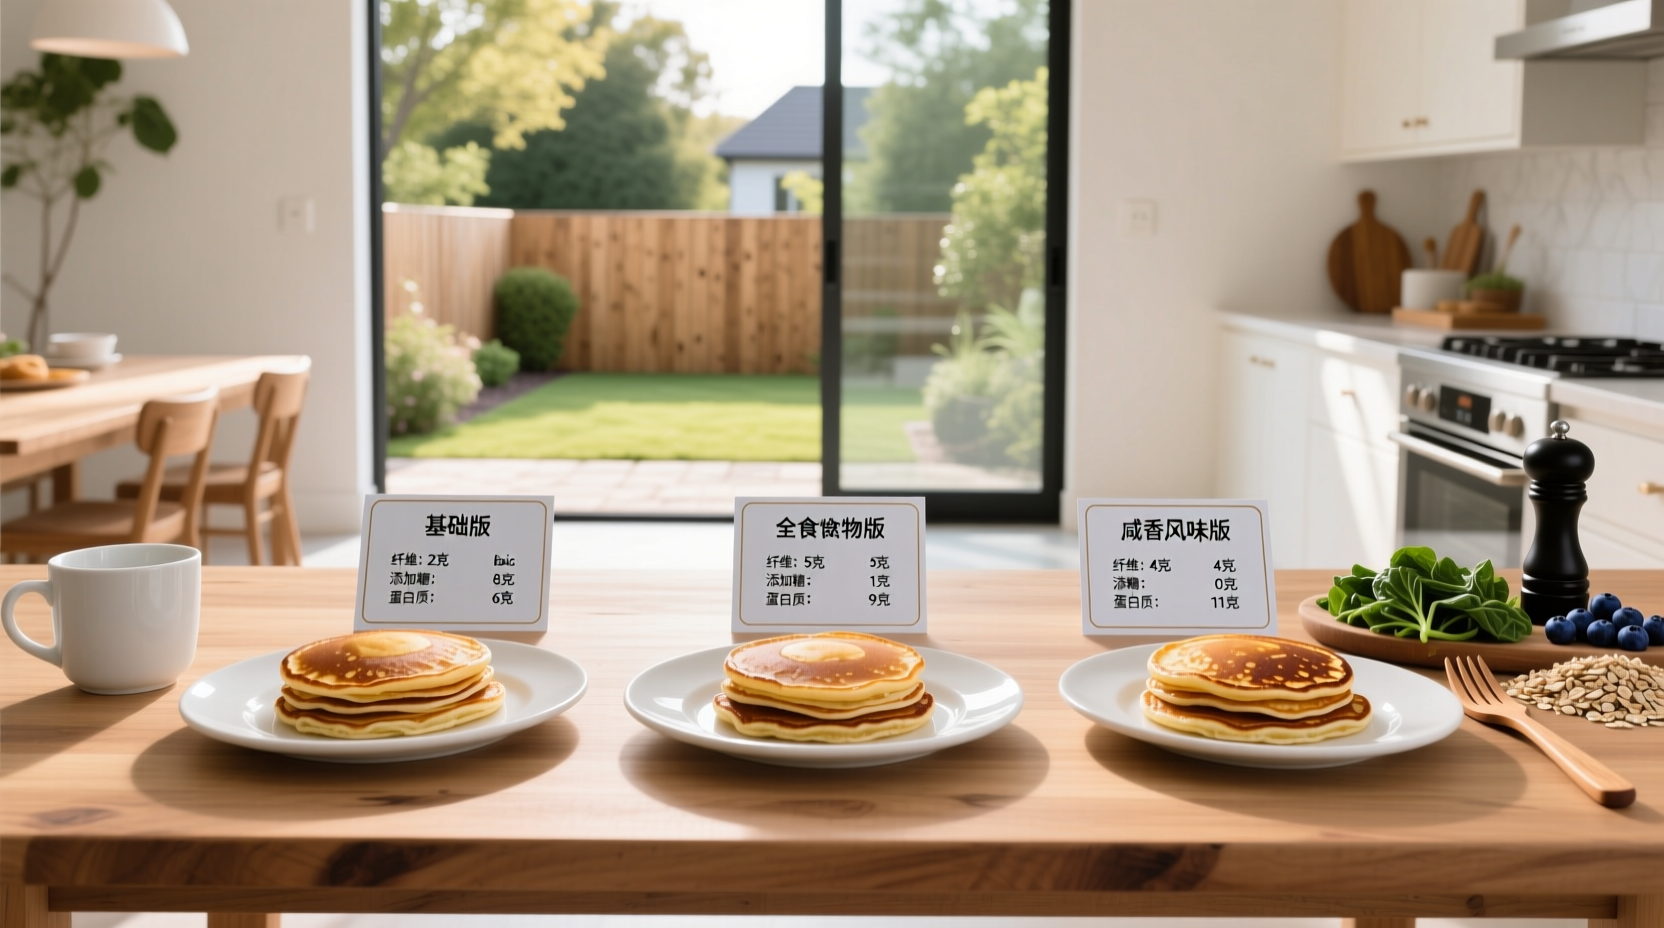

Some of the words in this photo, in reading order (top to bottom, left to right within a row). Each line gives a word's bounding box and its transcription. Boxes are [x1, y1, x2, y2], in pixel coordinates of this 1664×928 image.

[425, 514, 490, 537] 基础版
[1121, 519, 1231, 543] 咸香风味版
[869, 555, 890, 570] 5克
[1213, 558, 1237, 573] 4克
[493, 572, 515, 586] 8克
[869, 574, 891, 588] 1克
[1214, 577, 1239, 592] 0克
[491, 590, 514, 605] 6克
[868, 592, 891, 607] 9克
[1210, 595, 1240, 610] 11克
